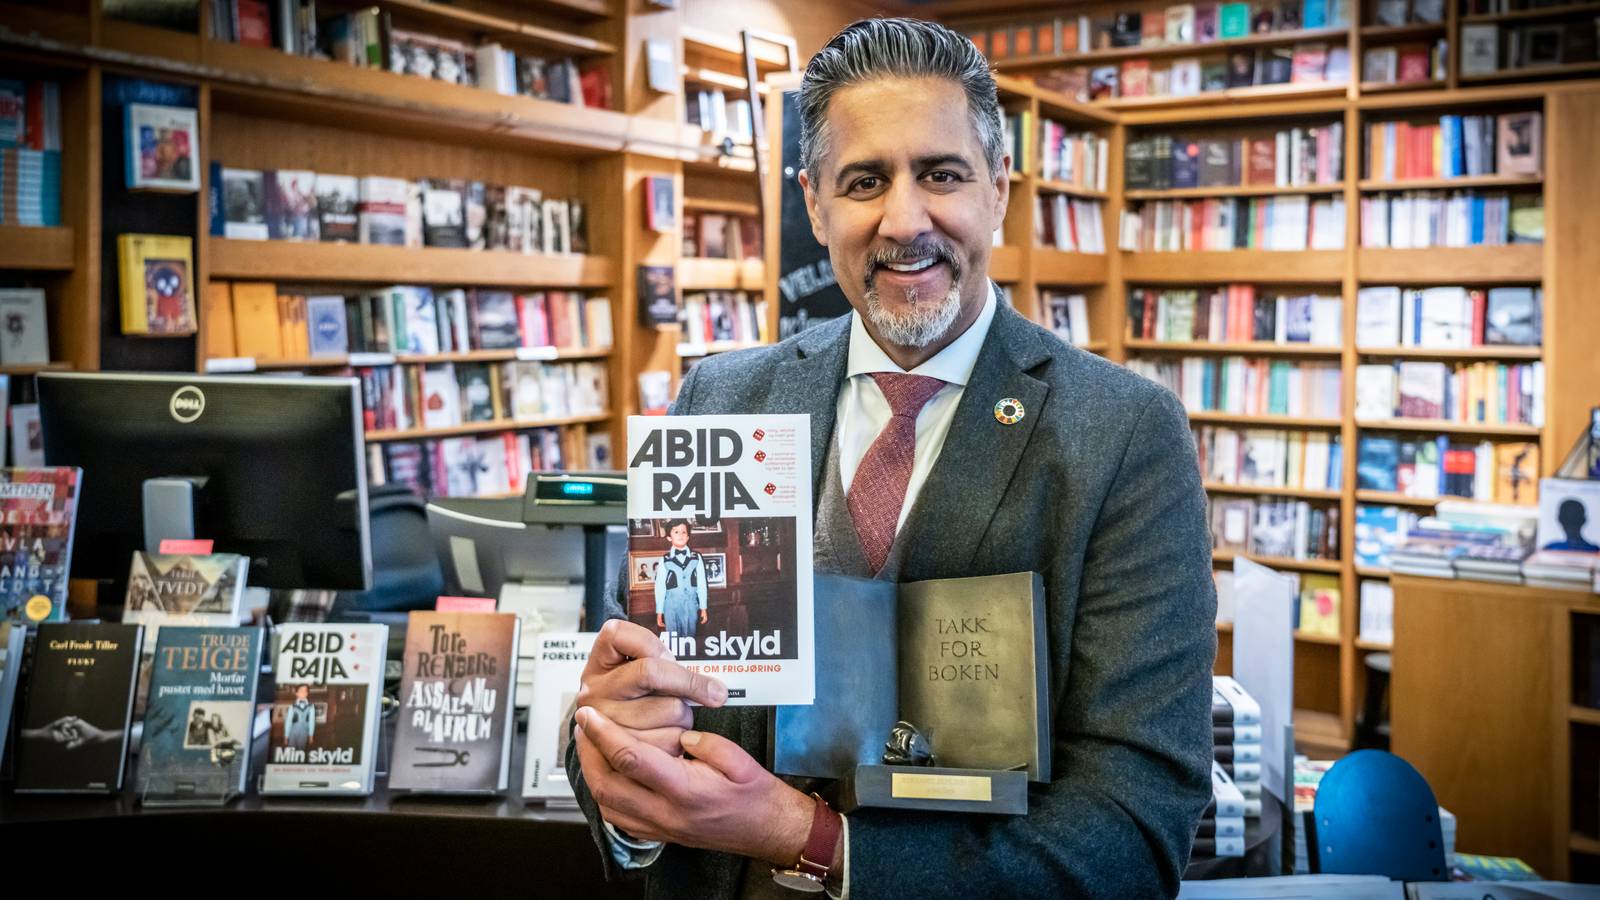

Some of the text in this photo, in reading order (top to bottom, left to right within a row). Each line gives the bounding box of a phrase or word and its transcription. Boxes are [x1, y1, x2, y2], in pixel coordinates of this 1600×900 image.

[630, 428, 743, 467] ABID
[653, 472, 760, 525] RAJA
[157, 581, 205, 596] TVEDT
[935, 617, 991, 634] TAKK
[49, 640, 118, 650] Carl Frode Tiller
[200, 633, 250, 646] TRUDE
[282, 632, 344, 653] ABID
[543, 640, 577, 649] EMILY
[704, 629, 781, 661] skyld
[542, 652, 587, 661] FOREVE
[940, 640, 986, 657] FOR
[162, 646, 249, 671] TEIGE
[291, 657, 349, 686] RAJA
[703, 665, 719, 673] OM
[722, 664, 782, 673] FRIGJØRING
[929, 664, 999, 682] BOKEN
[210, 671, 246, 684] Morfar
[159, 683, 244, 697] pustet med havet
[274, 746, 353, 766] Min skyld
